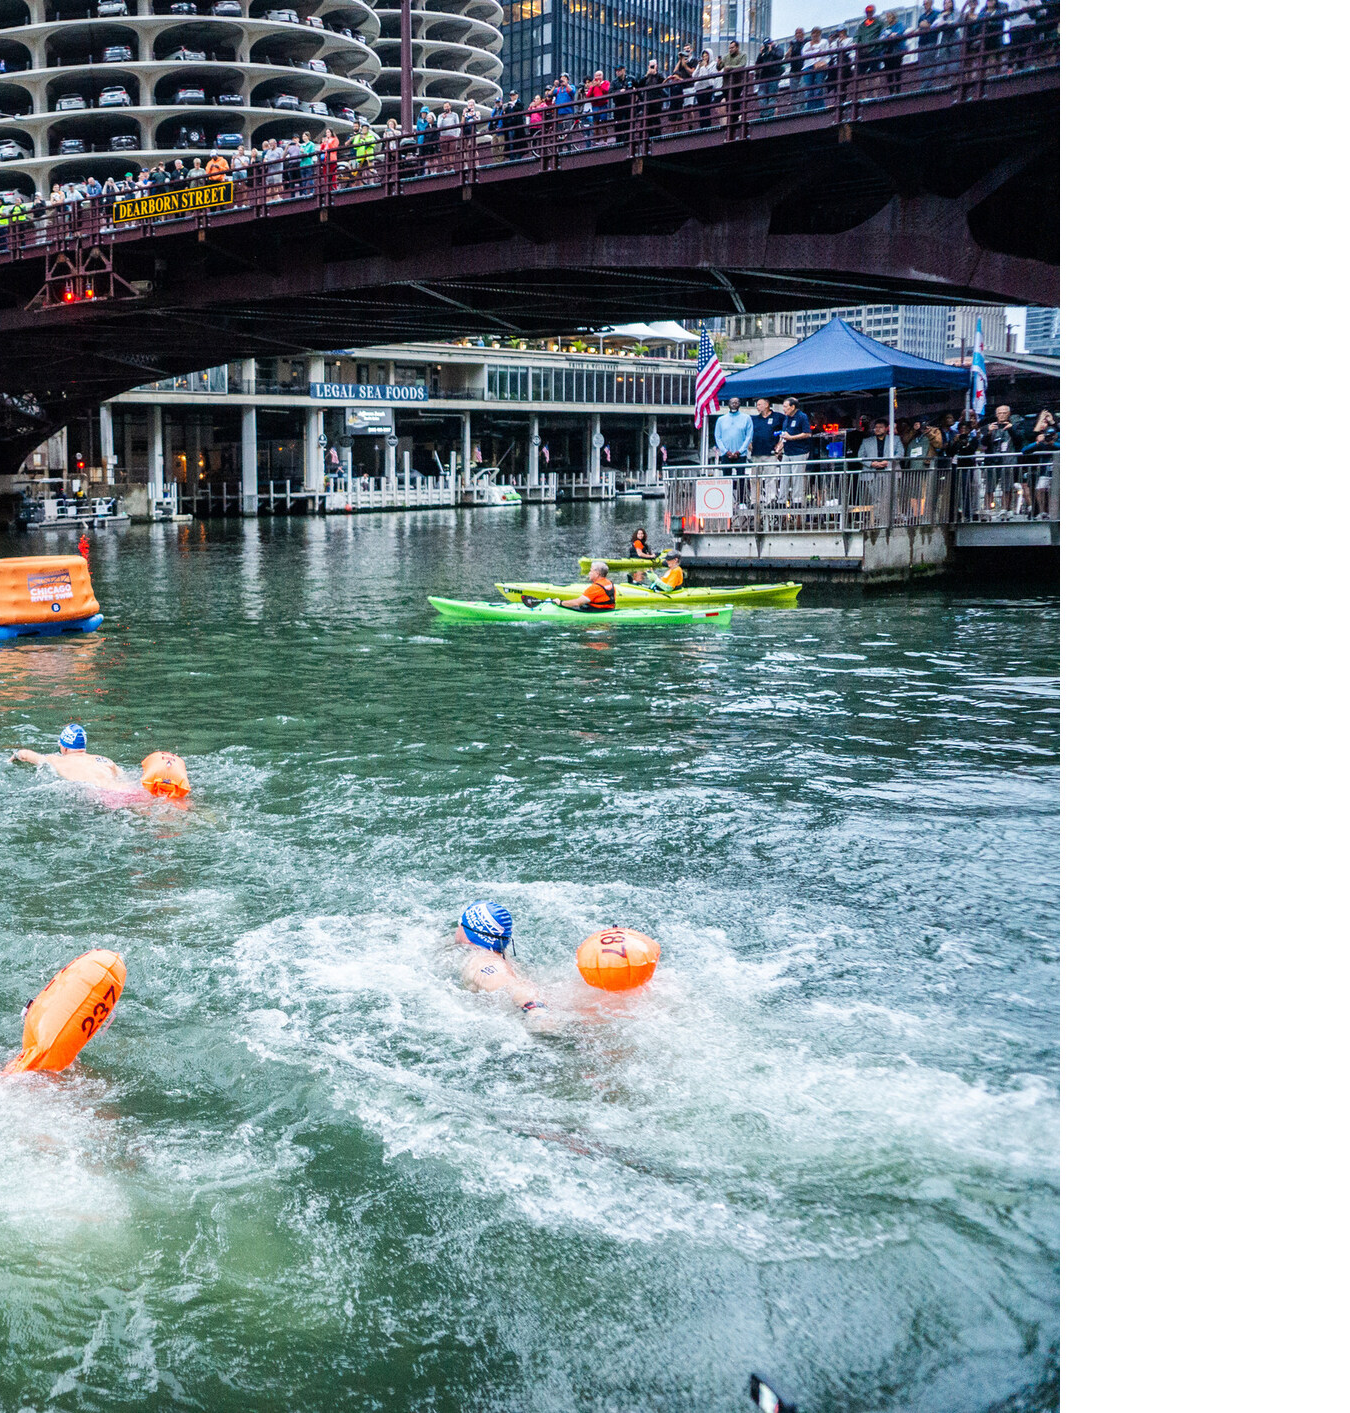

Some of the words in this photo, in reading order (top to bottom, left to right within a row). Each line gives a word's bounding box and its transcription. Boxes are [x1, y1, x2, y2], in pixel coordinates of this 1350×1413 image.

[119, 194, 179, 219] DEARBORN
[181, 186, 226, 208] STREET
[315, 384, 356, 398] LEGAL
[359, 385, 382, 399] SEA
[385, 386, 425, 400] FOODS
[30, 584, 72, 596] CHICAGO
[31, 595, 54, 603] RIVER
[55, 591, 74, 600] SWIM
[53, 604, 60, 612] B
[600, 930, 628, 959] 187
[480, 965, 499, 976] 187
[81, 984, 116, 1039] 237
